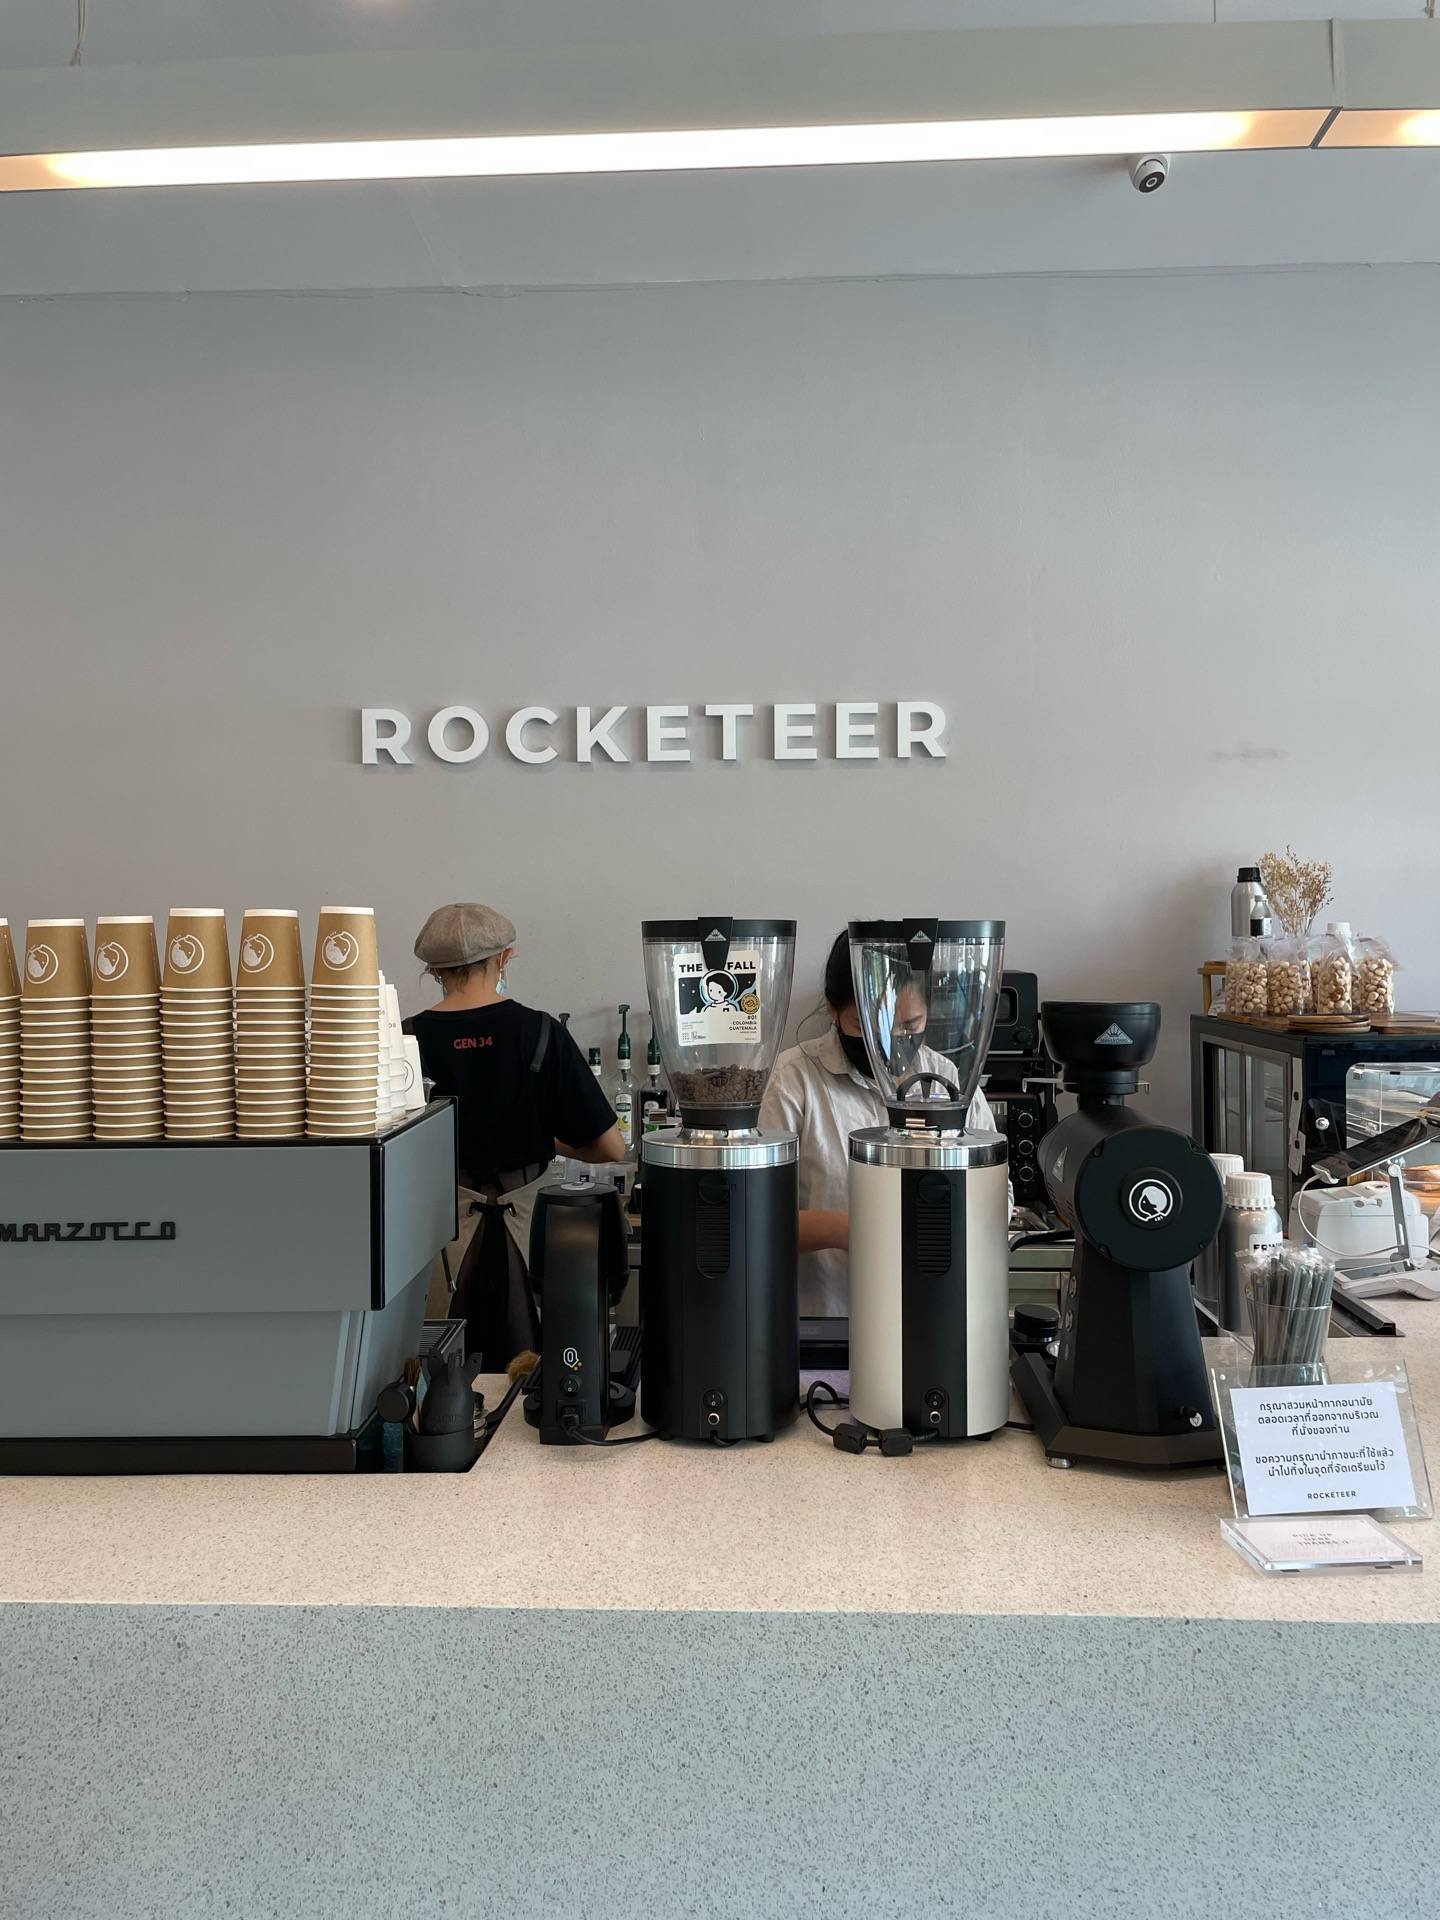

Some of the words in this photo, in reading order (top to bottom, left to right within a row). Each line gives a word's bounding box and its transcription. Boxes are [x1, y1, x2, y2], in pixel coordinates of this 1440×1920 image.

[361, 701, 948, 765] ROCKETEER
[679, 963, 703, 973] THE
[727, 961, 756, 970] FALL
[453, 1037, 477, 1049] GEN
[1259, 1396, 1373, 1414] กรุณาสวมหน้ากากอนามัย
[1257, 1409, 1379, 1425] ตลอดเวลาที่ออกจากบริเวณ
[1291, 1422, 1350, 1437] ที่นั่งของท่าน
[1307, 1490, 1357, 1500] ROCKETEER
